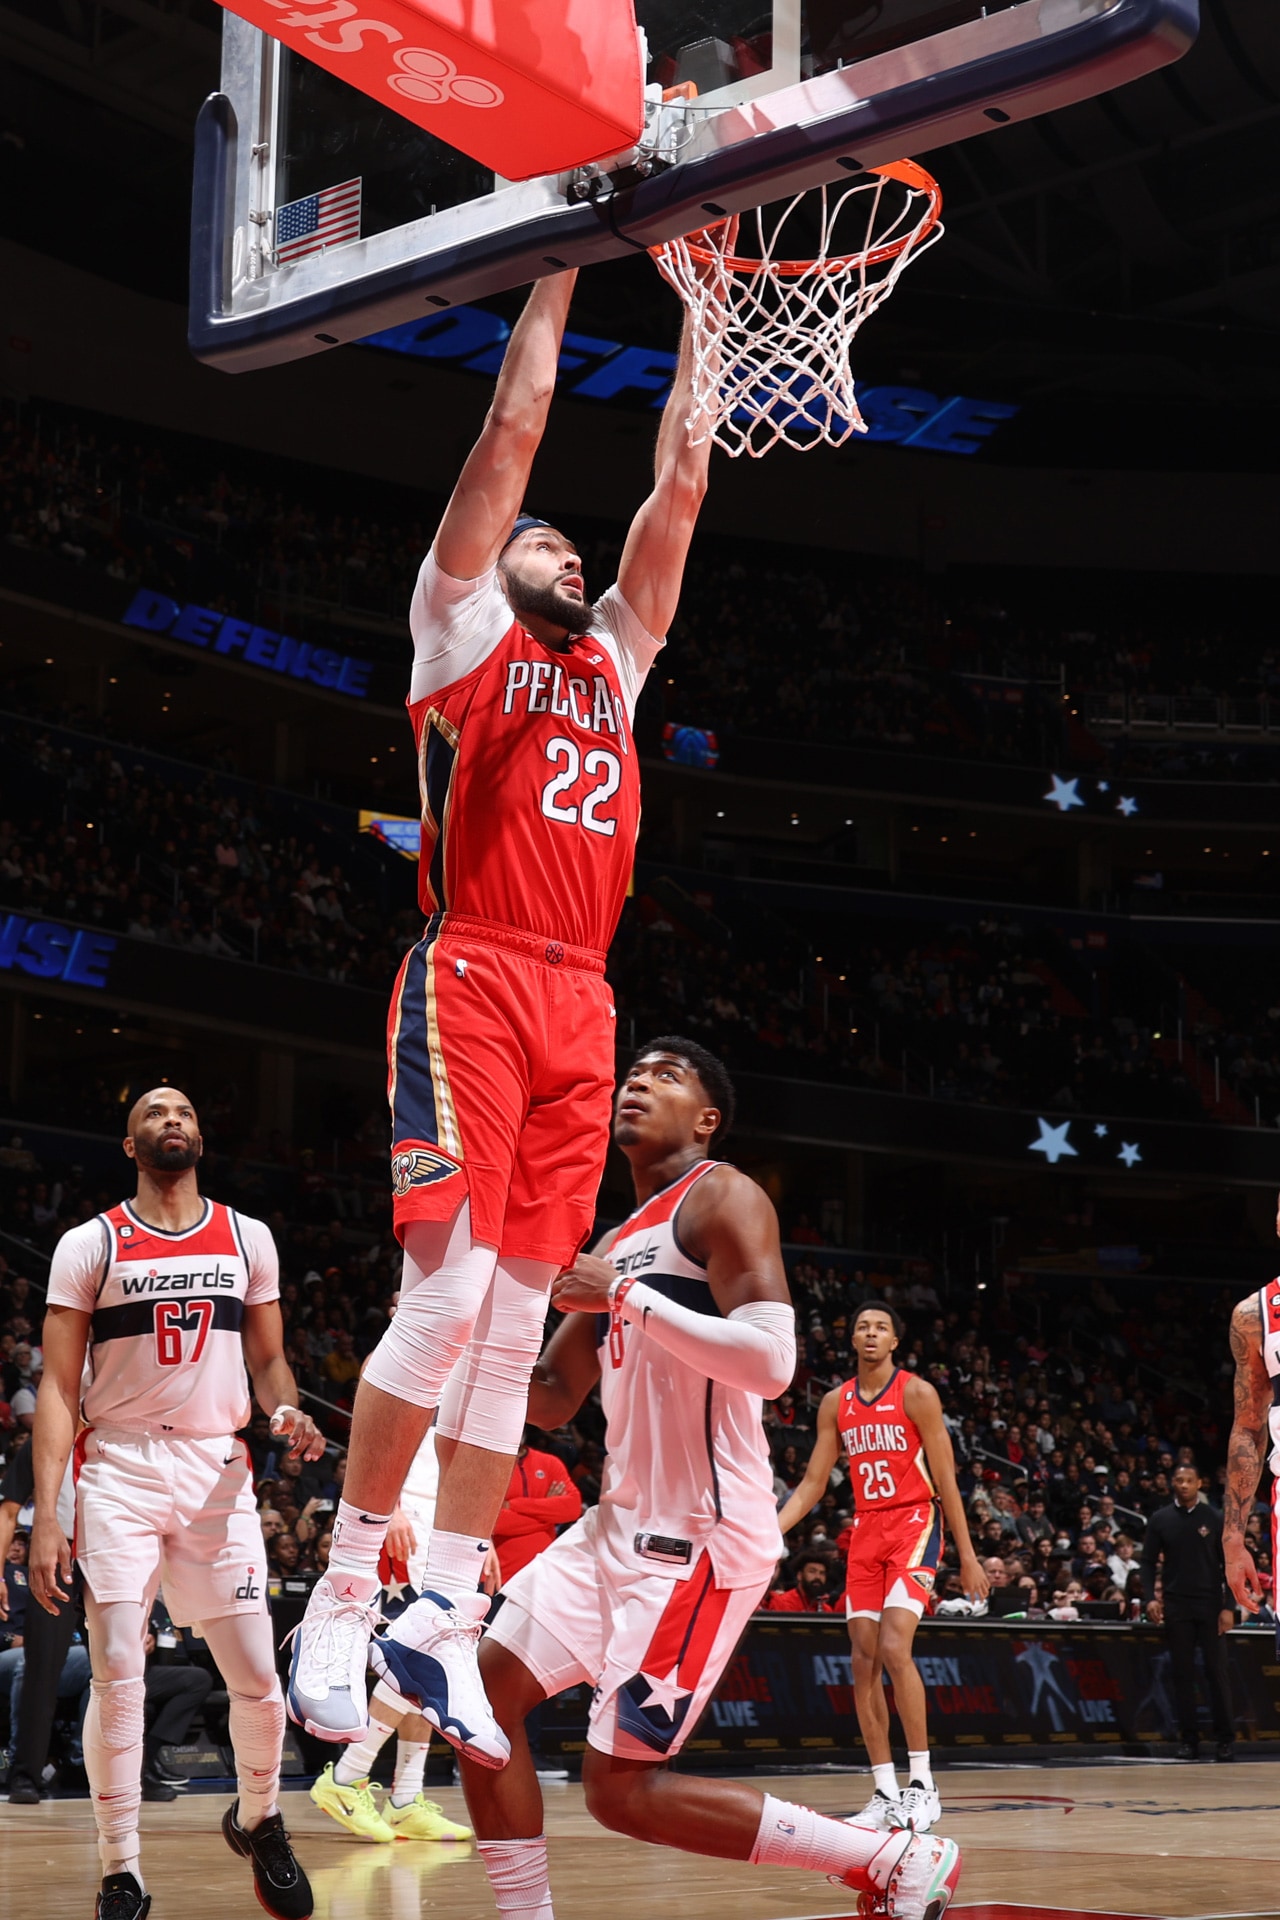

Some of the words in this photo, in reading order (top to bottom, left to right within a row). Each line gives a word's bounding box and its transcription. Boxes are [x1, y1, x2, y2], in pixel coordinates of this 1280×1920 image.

[120, 585, 374, 698] DEFENSE
[541, 735, 623, 837] 22
[614, 1236, 662, 1275] ards
[121, 1263, 237, 1296] wizards
[154, 1299, 214, 1367] 67
[841, 1423, 908, 1457] PELICANS
[858, 1459, 897, 1500] 25
[711, 1700, 760, 1728] LIVE
[1078, 1699, 1118, 1723] LIVE
